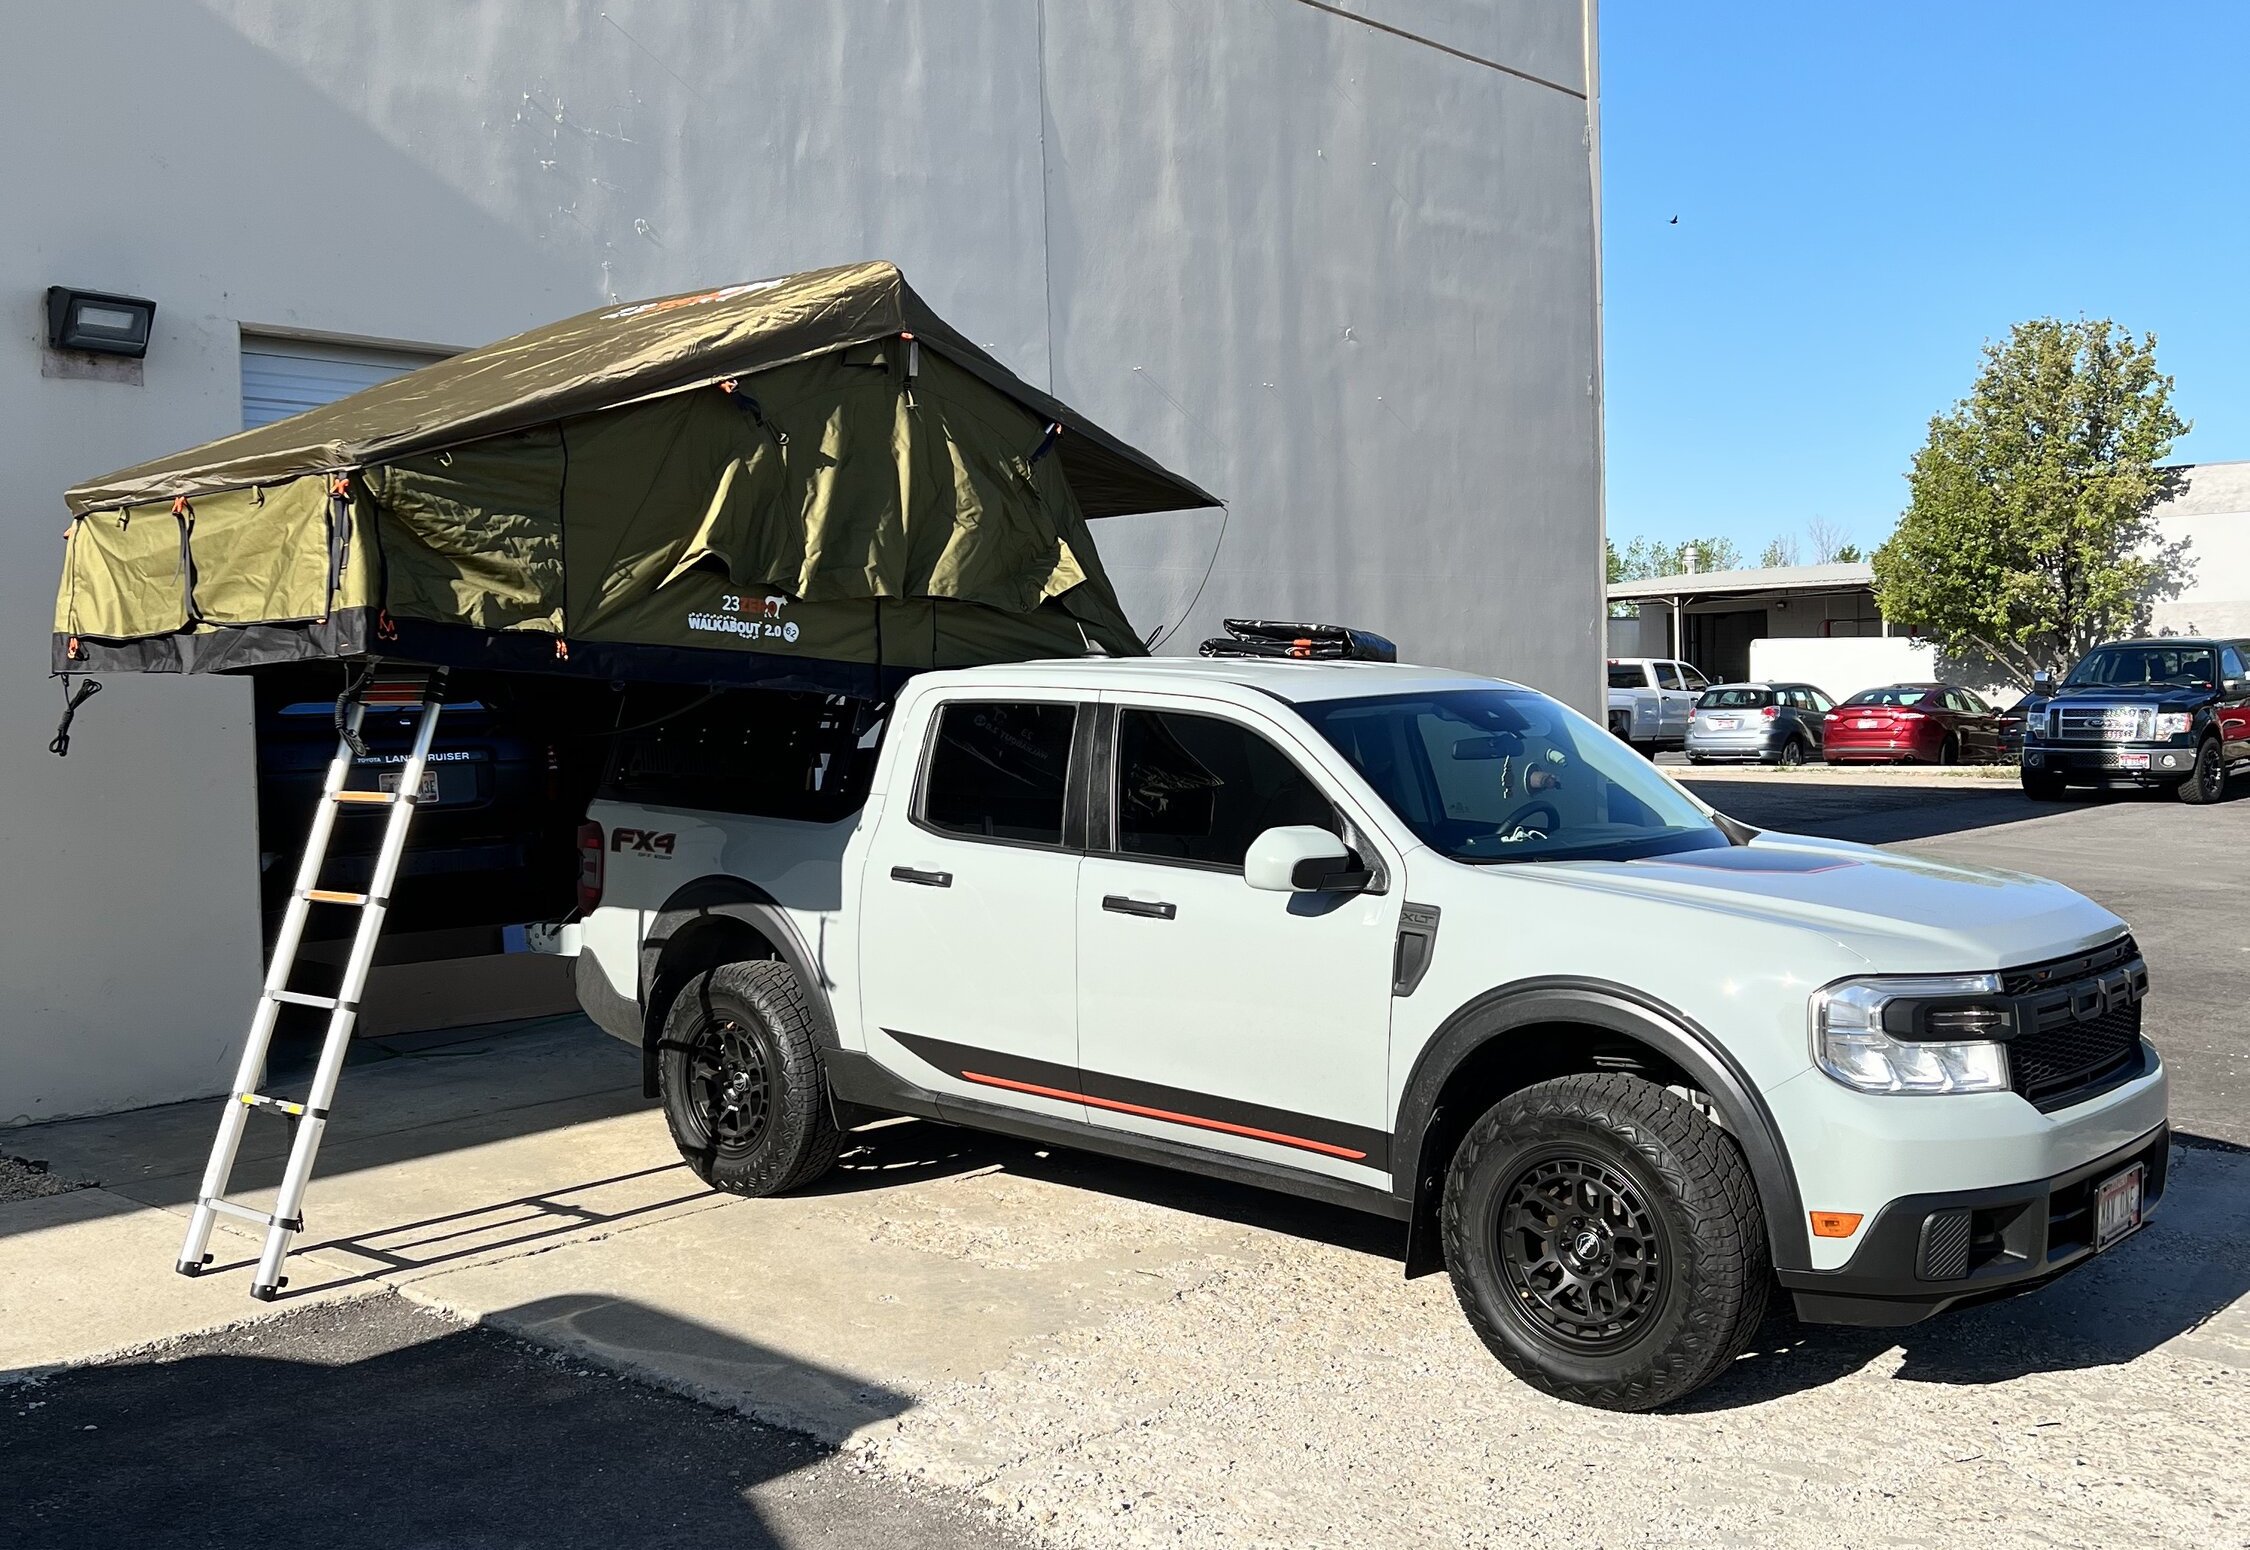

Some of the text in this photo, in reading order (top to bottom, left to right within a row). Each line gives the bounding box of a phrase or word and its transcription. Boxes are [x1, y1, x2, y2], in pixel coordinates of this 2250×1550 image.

[688, 614, 762, 636] WALKABOUT
[764, 624, 782, 637] 2.0
[385, 755, 413, 763] LAN
[427, 751, 470, 761] RUISER
[611, 828, 677, 854] FX4
[1401, 912, 1435, 924] XLT
[2014, 957, 2149, 1036] FORD
